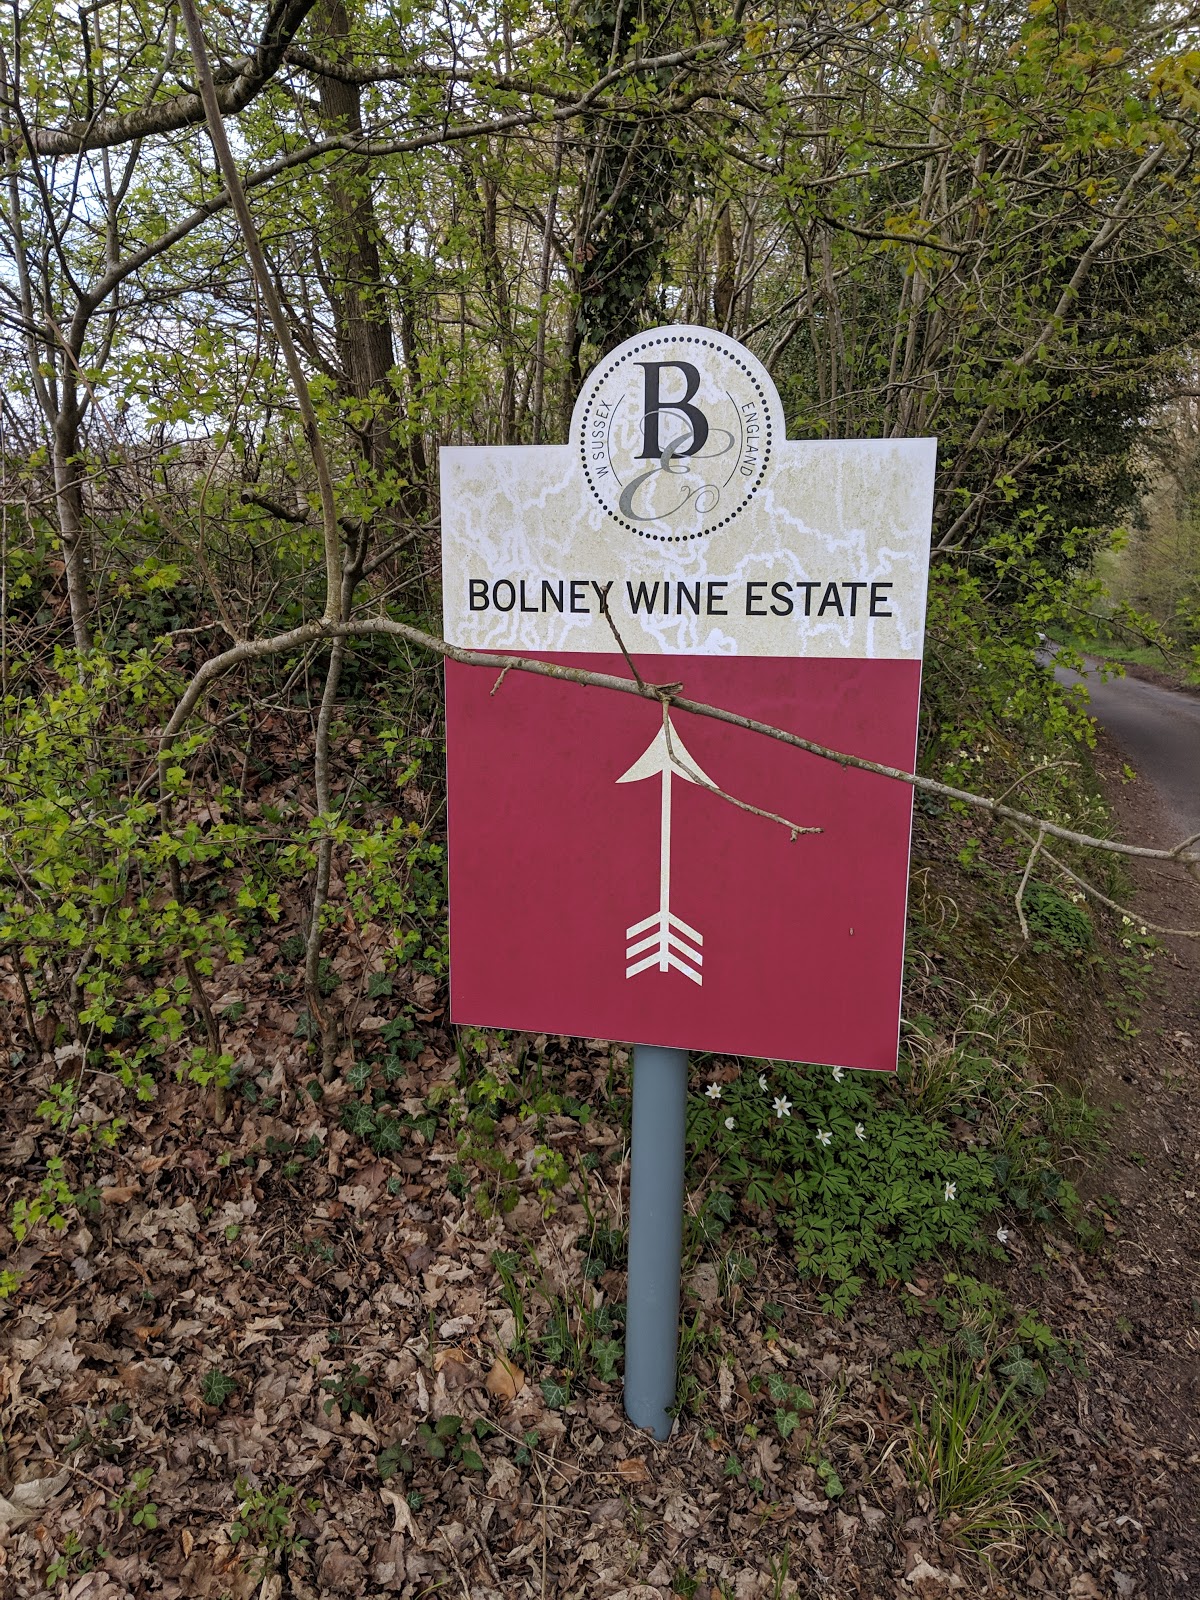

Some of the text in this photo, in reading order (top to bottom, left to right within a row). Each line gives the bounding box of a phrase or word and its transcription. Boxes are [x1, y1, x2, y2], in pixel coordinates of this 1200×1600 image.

[591, 399, 613, 479] W SUSSEX
[633, 360, 709, 460] B
[740, 401, 760, 477] ENGLAND
[468, 578, 893, 618] BOLNEY WINE ESTATE
